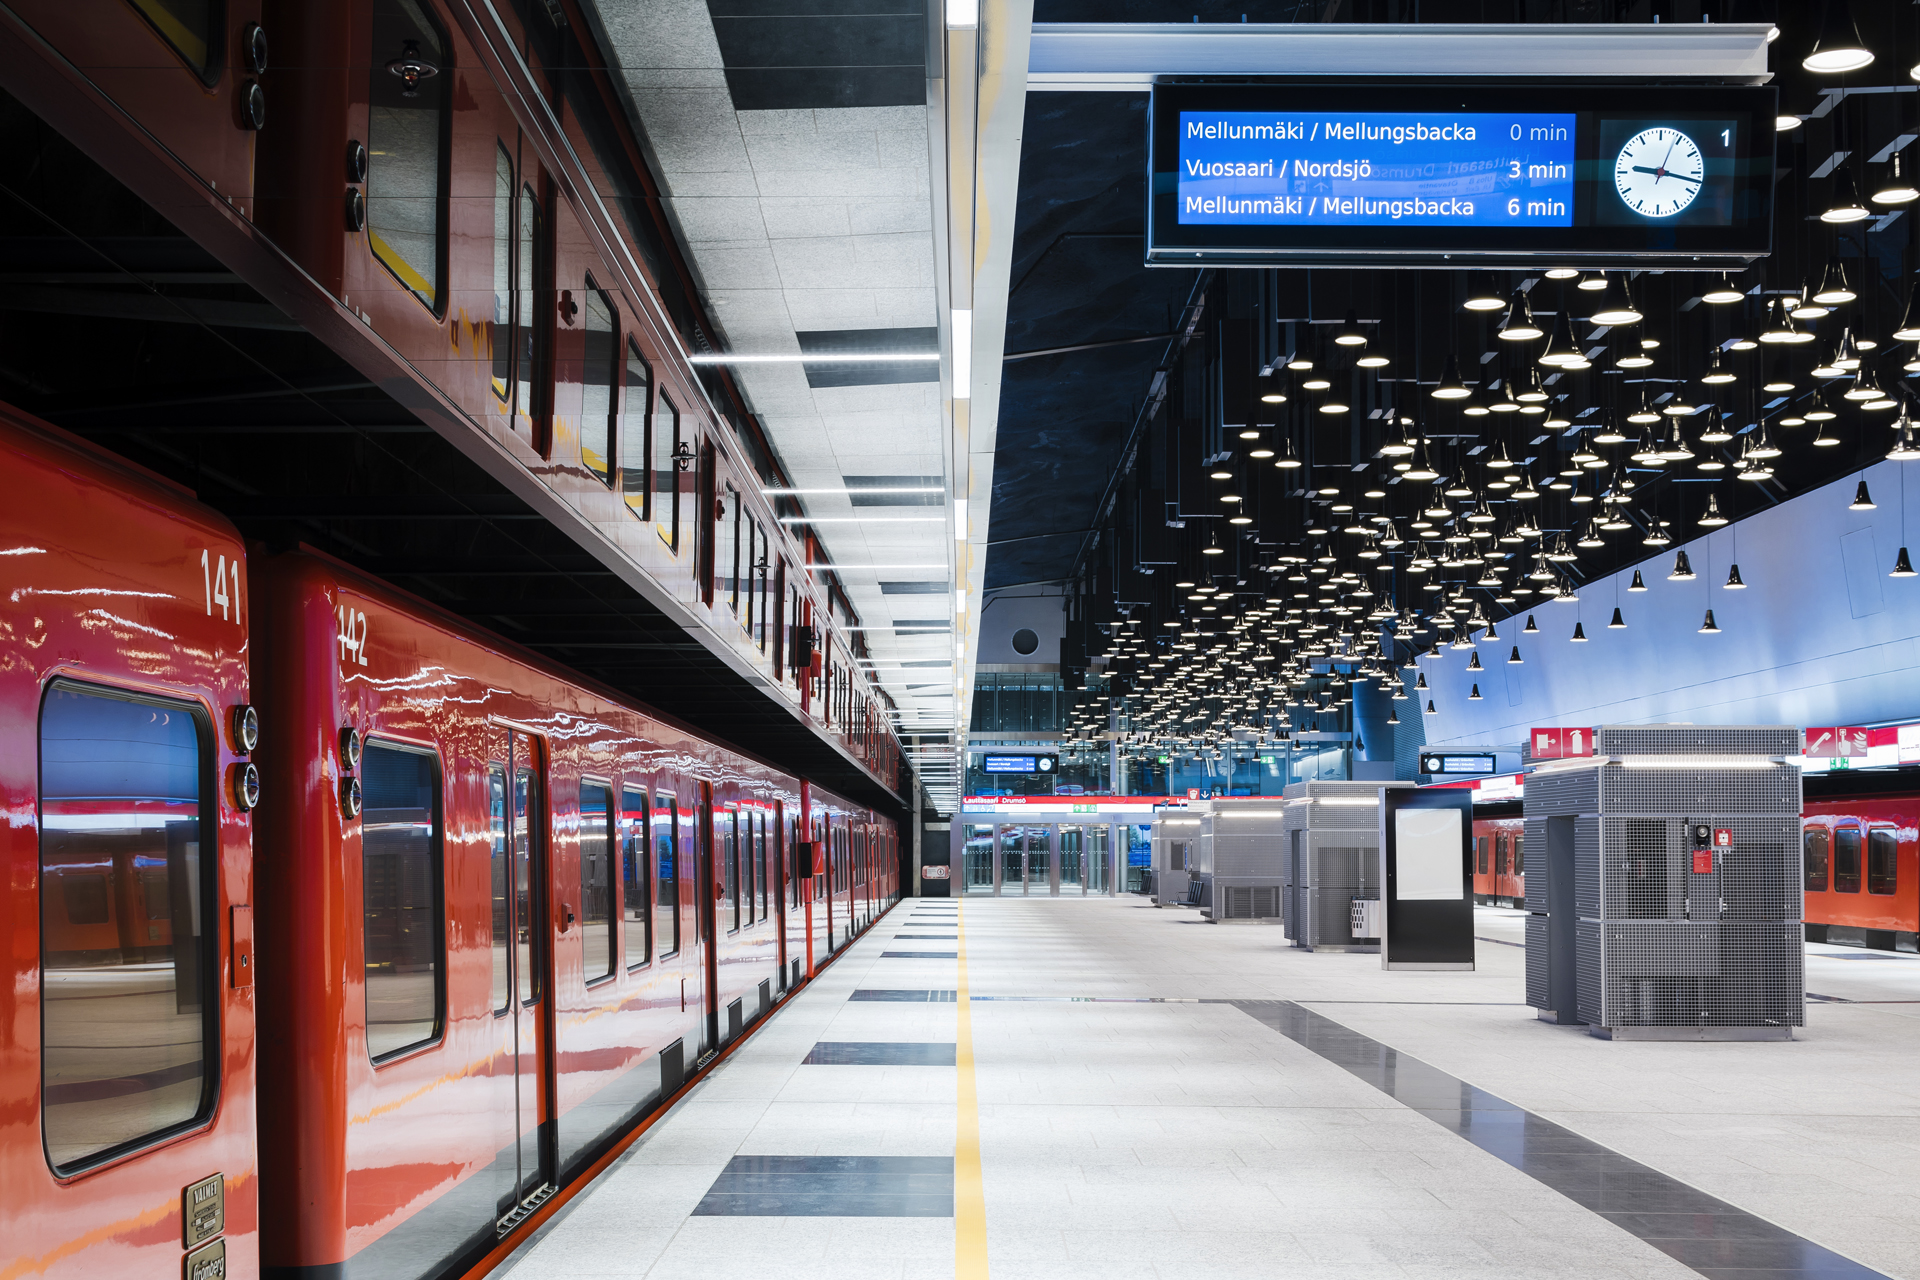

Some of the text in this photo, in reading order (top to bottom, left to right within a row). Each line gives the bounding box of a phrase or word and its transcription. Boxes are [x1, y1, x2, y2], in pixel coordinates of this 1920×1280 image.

[1187, 121, 1567, 145] Mellunmäki / Mellungsbacka 0 min
[1721, 129, 1730, 147] 1
[1186, 158, 1566, 182] Vuosaari / Nordsjö 3 min
[1186, 195, 1565, 219] Mellunmäki / Mellungsbacka 6 min
[201, 549, 241, 625] 141
[339, 604, 368, 667] 142
[194, 1180, 218, 1204] VALMET
